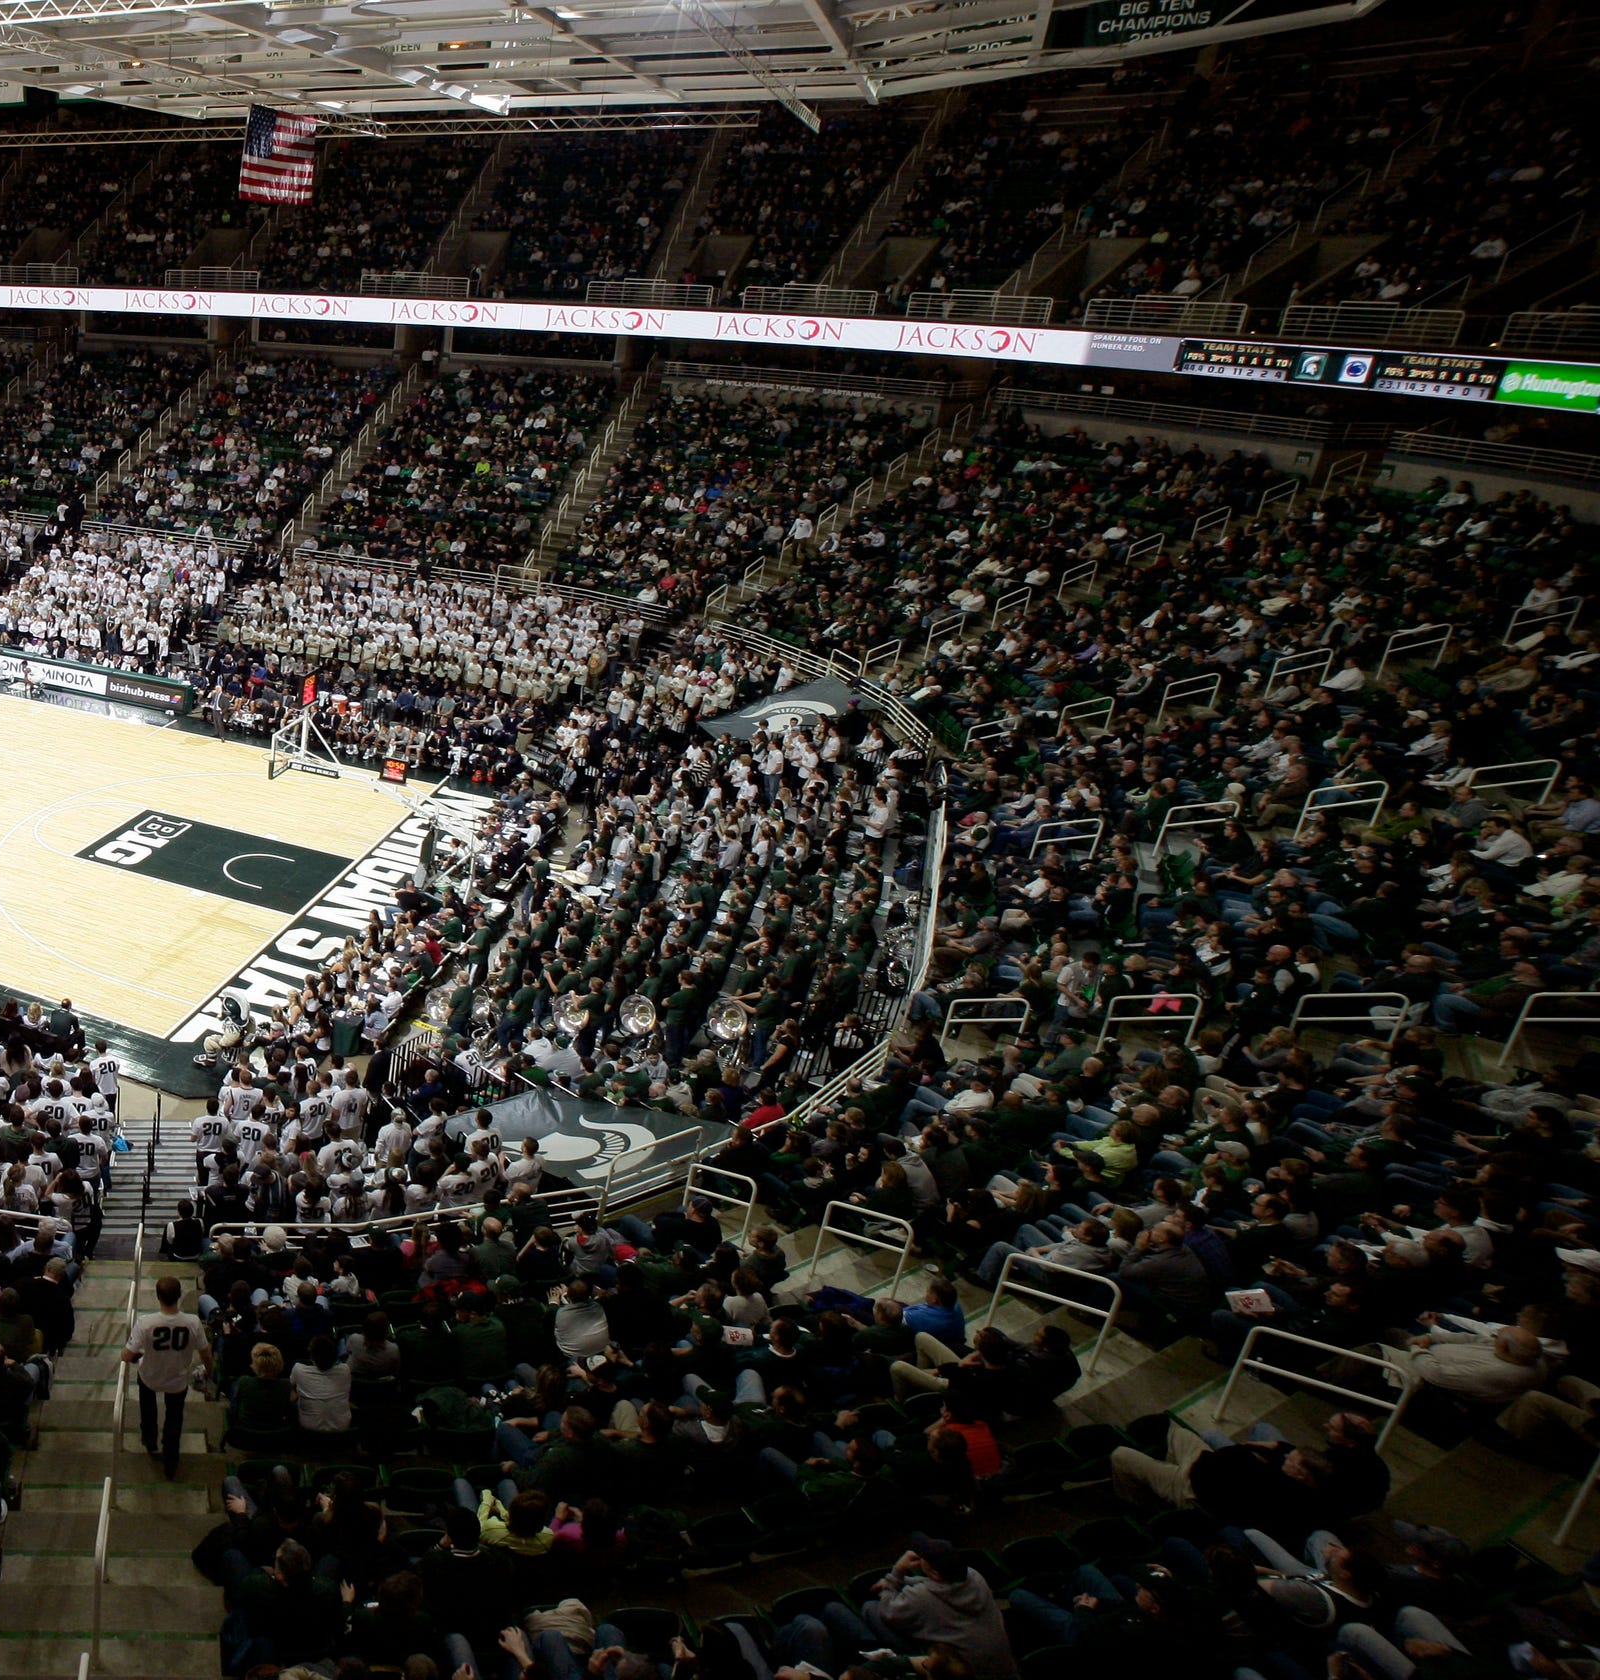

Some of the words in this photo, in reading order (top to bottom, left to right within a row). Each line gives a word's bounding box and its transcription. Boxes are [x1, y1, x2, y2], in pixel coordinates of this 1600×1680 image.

[1119, 3, 1150, 16] BIG
[1159, 0, 1196, 12] TEN
[1098, 10, 1211, 34] CHAMPIONS
[8, 288, 90, 306] JACKSON
[125, 291, 213, 311] JACKSON
[251, 294, 349, 317] JACKSON
[389, 301, 499, 325] JACKSON
[544, 307, 667, 332] JACKSON
[713, 315, 845, 341] JACKSON
[895, 324, 1040, 355] JACKSON
[1093, 334, 1126, 343] SPARTAN
[1128, 336, 1148, 344] FOUL
[1202, 342, 1235, 352] TEAM
[1237, 344, 1275, 355] STATS
[1207, 365, 1224, 374] 0.0
[1233, 367, 1242, 376] 11
[1402, 355, 1437, 367] TEAM
[1440, 358, 1483, 370] STATS
[1378, 379, 1400, 389] 23.1
[1404, 381, 1426, 392] 14.3
[1521, 373, 1600, 400] Huntington
[42, 667, 93, 688] MINOLTA
[110, 681, 144, 697] bizhub
[144, 690, 171, 702] PRESS
[465, 1051, 480, 1066] 20
[99, 1060, 116, 1075] 20
[44, 1105, 64, 1120] 20
[242, 1100, 250, 1112] 3
[309, 1101, 326, 1117] 20
[91, 1118, 108, 1131] 20
[264, 1111, 280, 1124] 20
[202, 1122, 222, 1136] 20
[242, 1126, 261, 1141] 20
[480, 1162, 499, 1183] 20
[453, 1181, 475, 1196] 20
[152, 1326, 190, 1352] 20
